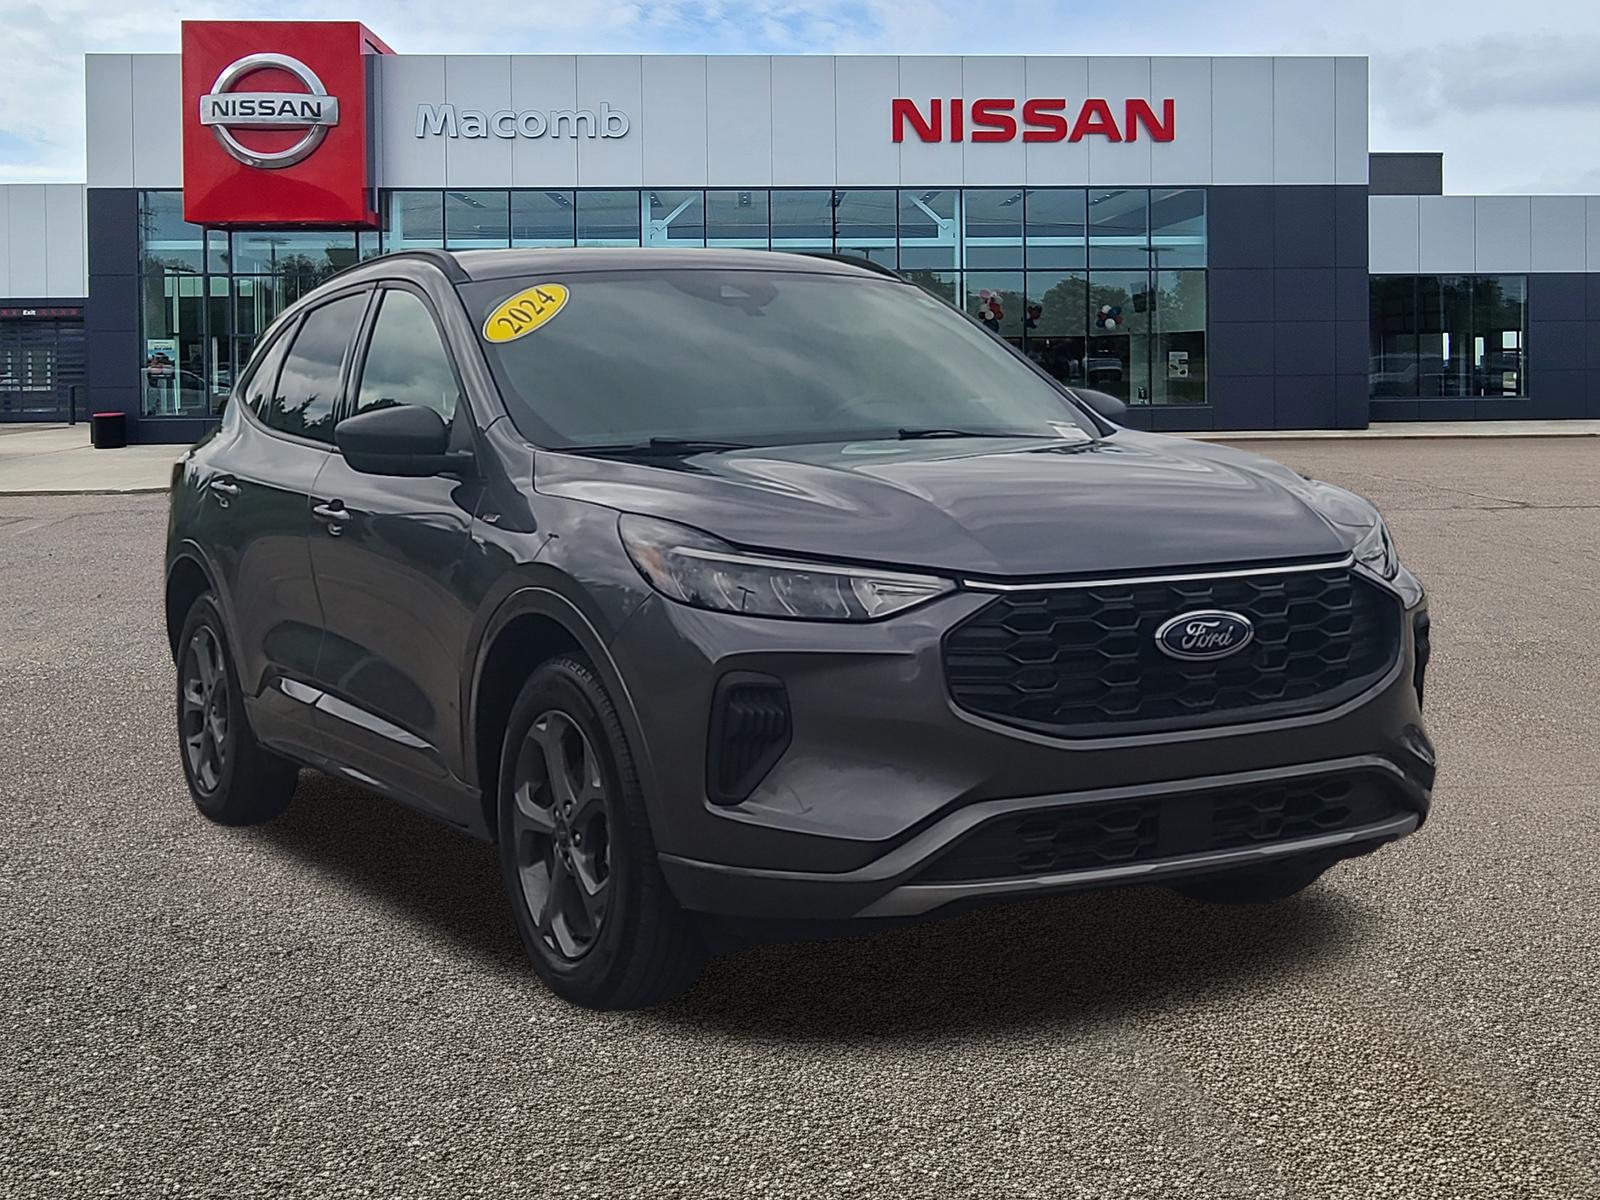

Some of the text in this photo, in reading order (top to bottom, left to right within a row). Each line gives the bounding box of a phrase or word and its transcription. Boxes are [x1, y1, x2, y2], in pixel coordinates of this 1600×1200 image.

[212, 100, 322, 119] NISSAN
[415, 102, 630, 139] Macomb
[892, 98, 1175, 142] NISSAN
[497, 289, 556, 334] 2024
[1182, 620, 1234, 649] Ford
